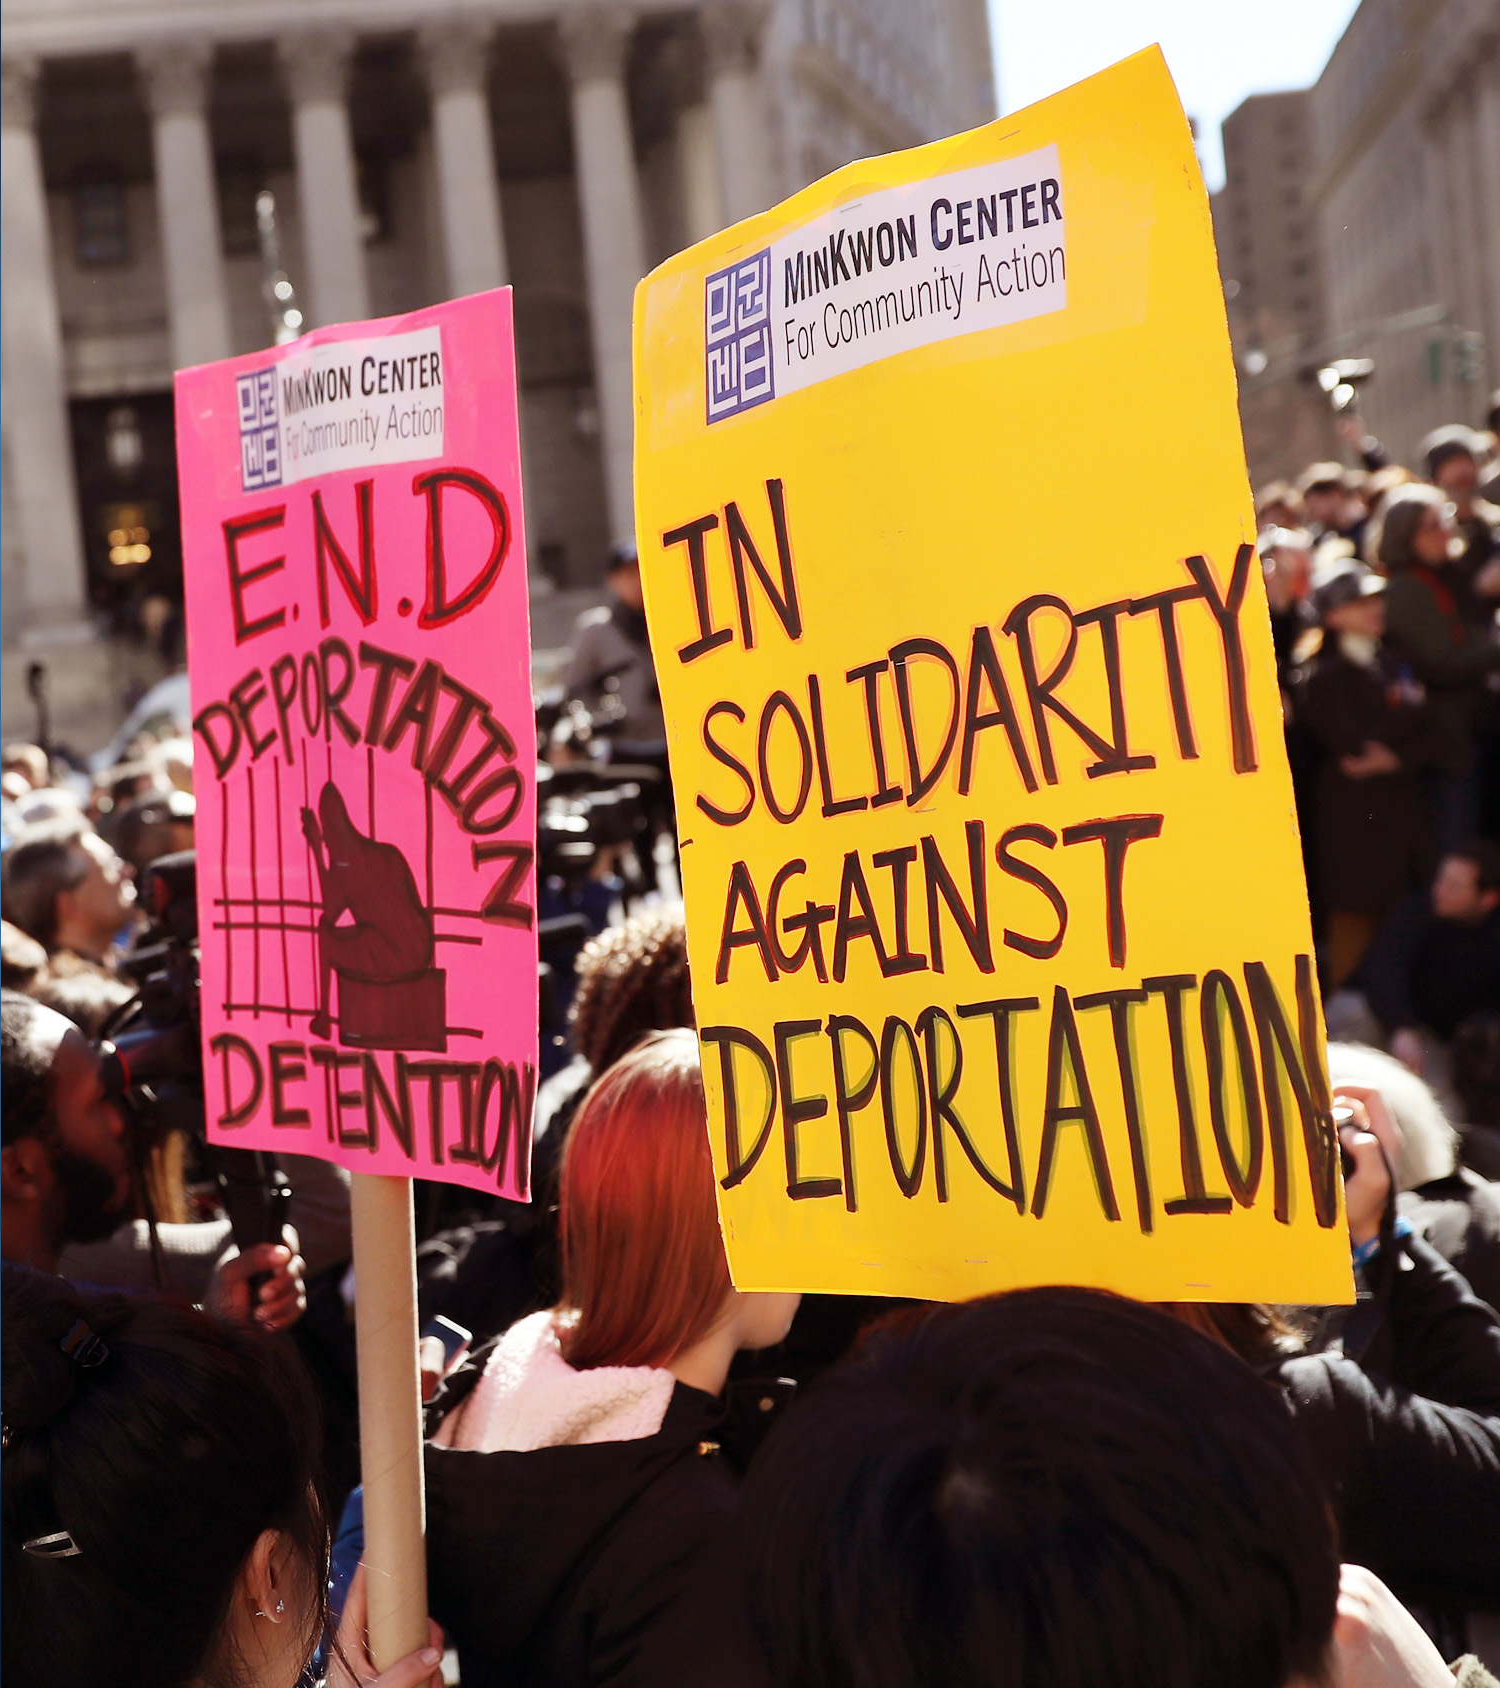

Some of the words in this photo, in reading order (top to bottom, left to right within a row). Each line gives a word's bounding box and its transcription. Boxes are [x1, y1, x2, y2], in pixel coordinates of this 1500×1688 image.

[930, 178, 1063, 251] CENTER
[361, 352, 442, 396] CENTER
[784, 318, 817, 366] For
[823, 265, 965, 350] Community
[976, 243, 1066, 303] Action
[302, 409, 380, 457] Community
[386, 401, 444, 444] Action
[663, 479, 803, 664] IN
[697, 543, 1259, 827] SOLIDARITY
[193, 636, 534, 930] DEPORTATION
[715, 813, 1164, 985] AGAINST
[211, 1033, 534, 1197] DETENTION
[701, 953, 1338, 1236] DEPORTATION
